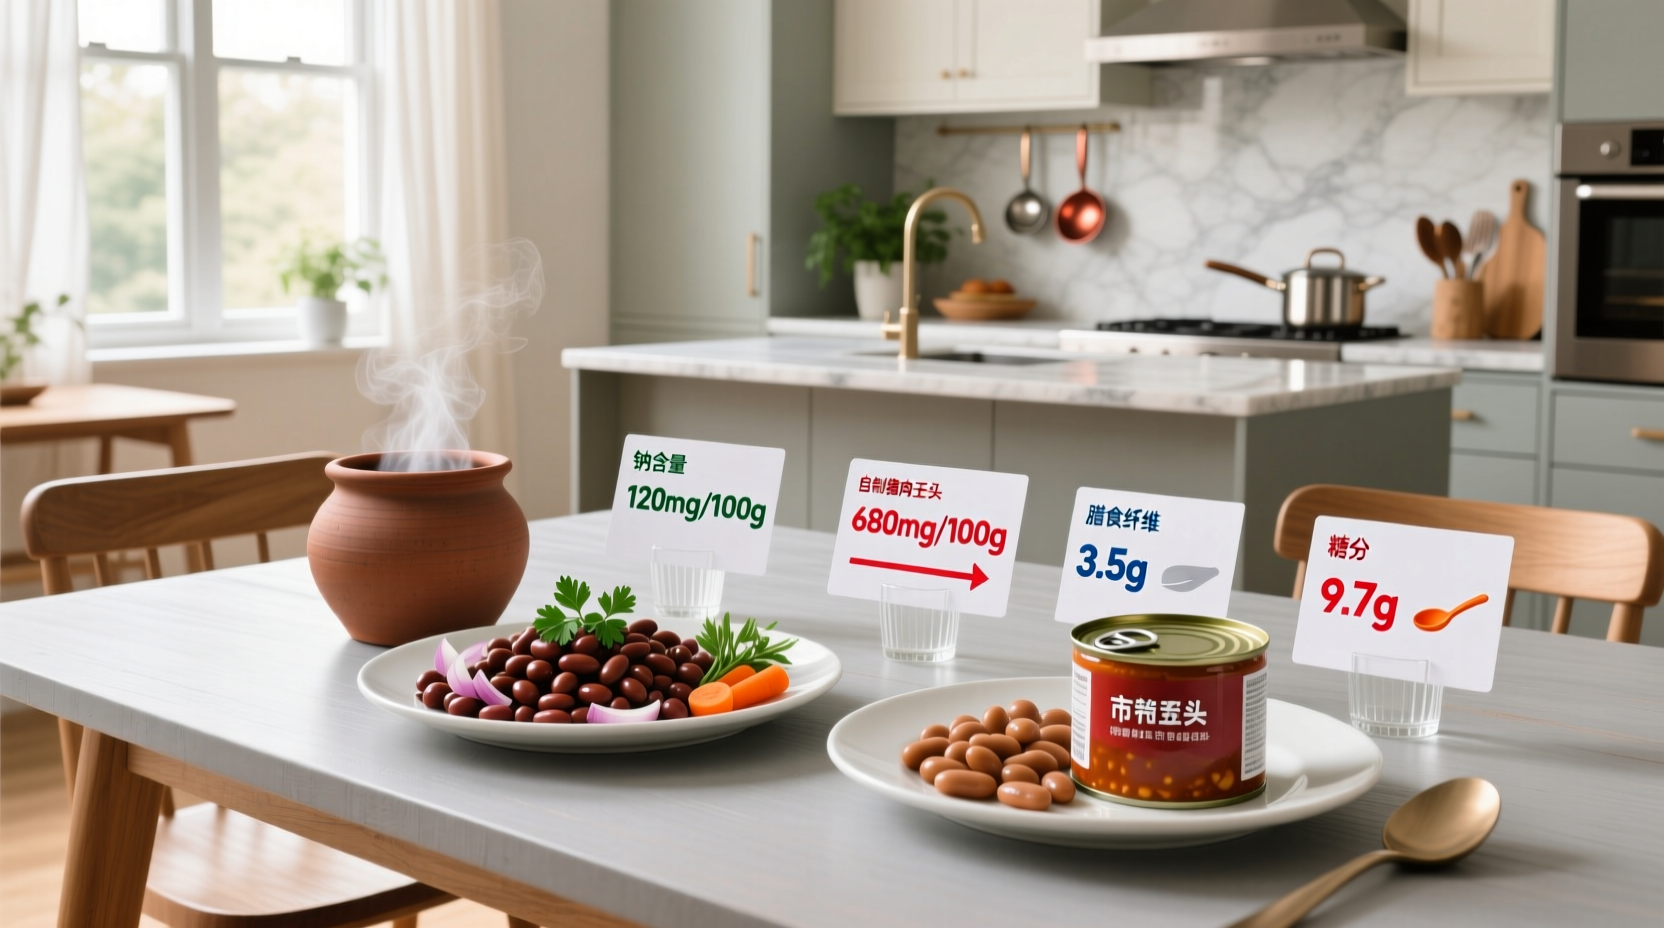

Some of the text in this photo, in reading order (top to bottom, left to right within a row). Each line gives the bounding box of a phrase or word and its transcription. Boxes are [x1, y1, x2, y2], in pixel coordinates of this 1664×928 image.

[633, 449, 688, 475] 钠含量
[627, 484, 767, 530] 120mg/100g
[851, 506, 1008, 557] 680mg/100g
[1328, 533, 1370, 561] 糖分
[1075, 543, 1149, 593] 3.5g
[1321, 577, 1399, 633] 9.7g
